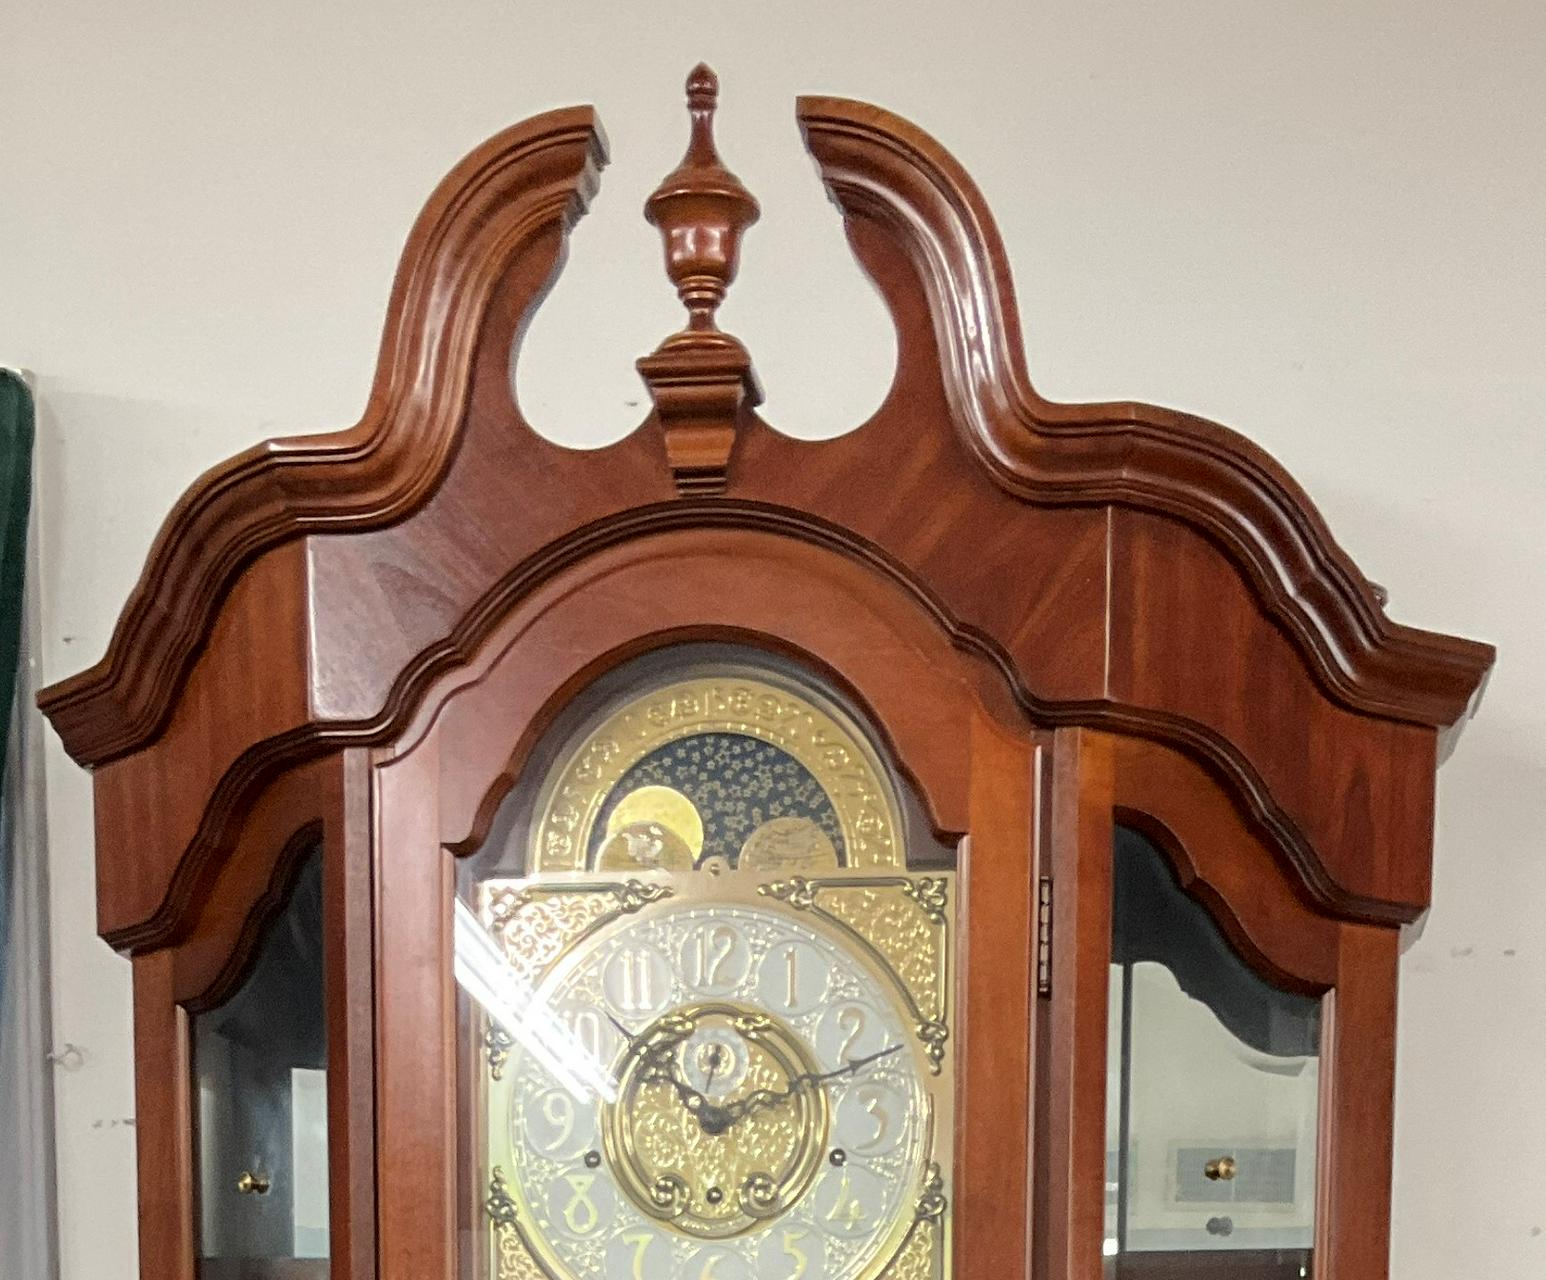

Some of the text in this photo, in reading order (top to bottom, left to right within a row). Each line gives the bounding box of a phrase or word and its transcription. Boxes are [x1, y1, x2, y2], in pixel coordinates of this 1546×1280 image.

[619, 948, 655, 1010] 11
[692, 926, 738, 988] 12
[782, 946, 799, 1008] 1
[836, 1005, 866, 1067] 2
[542, 1092, 576, 1151] 9
[856, 1088, 889, 1150] 3
[562, 1174, 599, 1234] 8
[826, 1169, 867, 1230] 4
